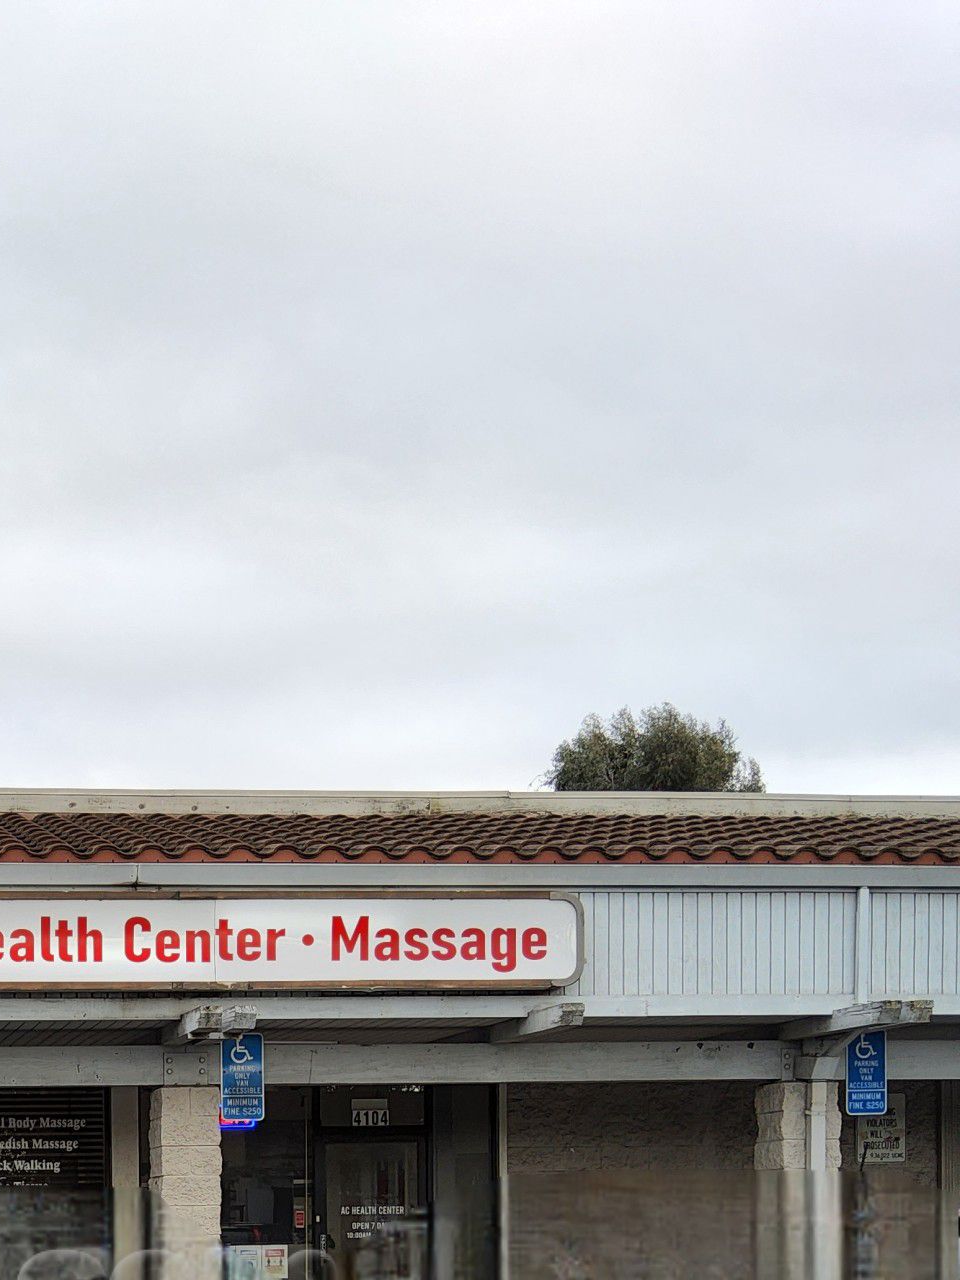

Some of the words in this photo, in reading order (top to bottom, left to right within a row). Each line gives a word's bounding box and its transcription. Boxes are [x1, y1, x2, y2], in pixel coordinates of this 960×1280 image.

[124, 916, 286, 963] Center
[331, 915, 548, 973] Massage
[849, 1081, 884, 1089] ACCESSIBLE
[224, 1107, 241, 1115] FINE
[353, 1110, 389, 1126] 4104
[866, 1118, 898, 1128] VIOLATORS
[8, 1117, 37, 1131] Body
[39, 1117, 87, 1131] Massage
[870, 1130, 882, 1139] WILL
[31, 1138, 80, 1152] Massage
[13, 1159, 61, 1174] Walking
[340, 1206, 350, 1215] AC
[351, 1206, 377, 1215] HEALTH
[378, 1206, 405, 1215] CENTER
[351, 1221, 370, 1230] OPEN
[371, 1221, 376, 1230] 7
